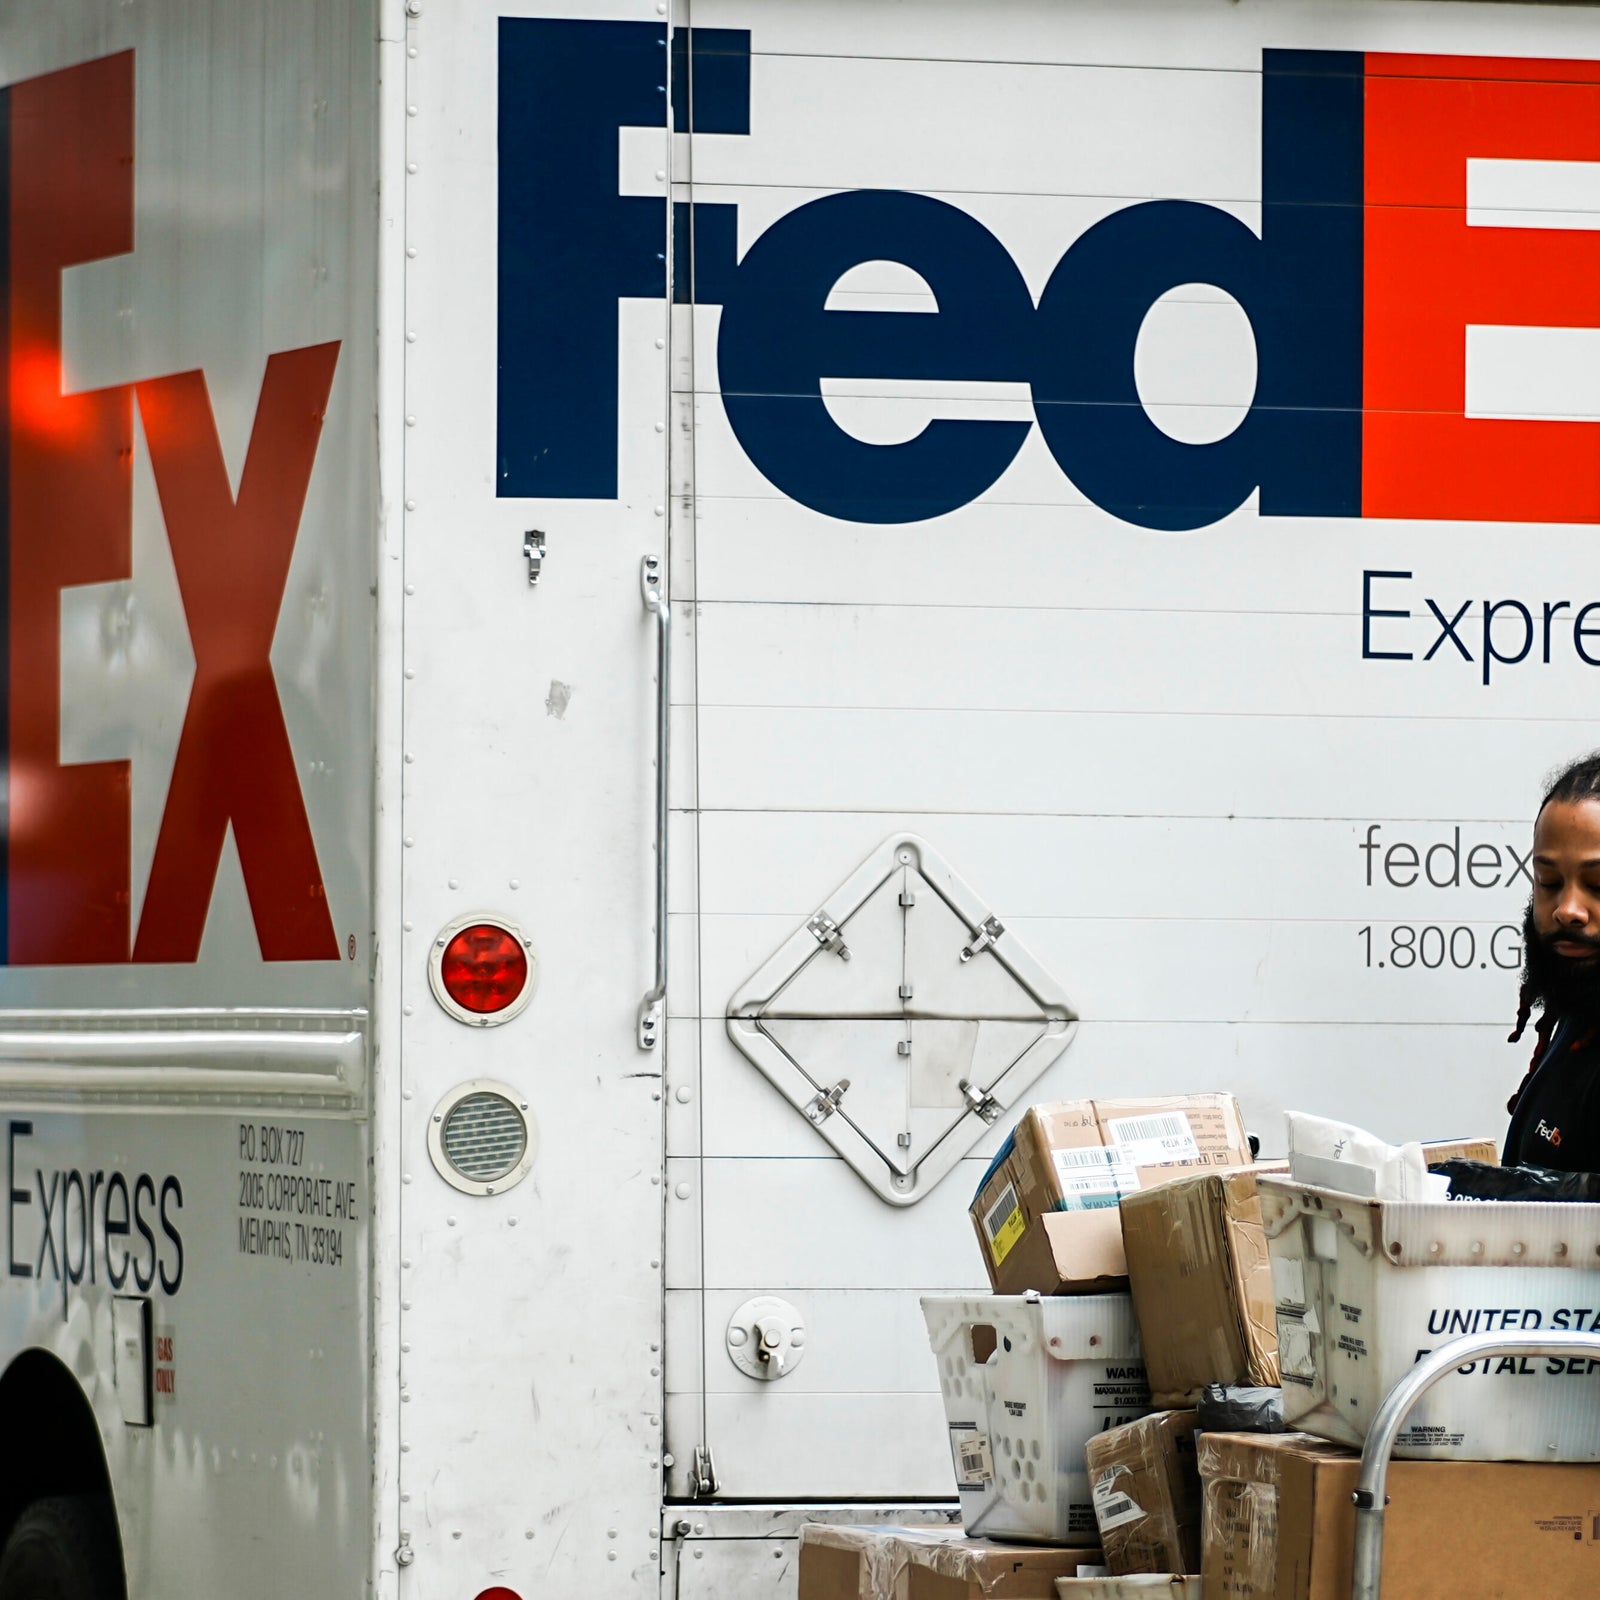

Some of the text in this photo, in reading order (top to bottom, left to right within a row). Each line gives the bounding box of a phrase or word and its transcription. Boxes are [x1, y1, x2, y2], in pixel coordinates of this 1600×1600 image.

[0, 48, 341, 966] Ex
[260, 1126, 284, 1166] BOX
[285, 1129, 305, 1167] 727
[239, 1171, 265, 1210] 2005
[266, 1173, 333, 1218] CORPORATE
[9, 1119, 183, 1322] Express
[238, 1216, 294, 1265] MEMPHIS,
[294, 1222, 310, 1262] TN
[1427, 1308, 1542, 1335] UNITED
[156, 1336, 173, 1362] GAS
[1414, 1349, 1535, 1375] STAL
[155, 1367, 176, 1394] ONLY
[1094, 1386, 1131, 1395] MAXIMUM
[1410, 1425, 1446, 1433] WARNING
